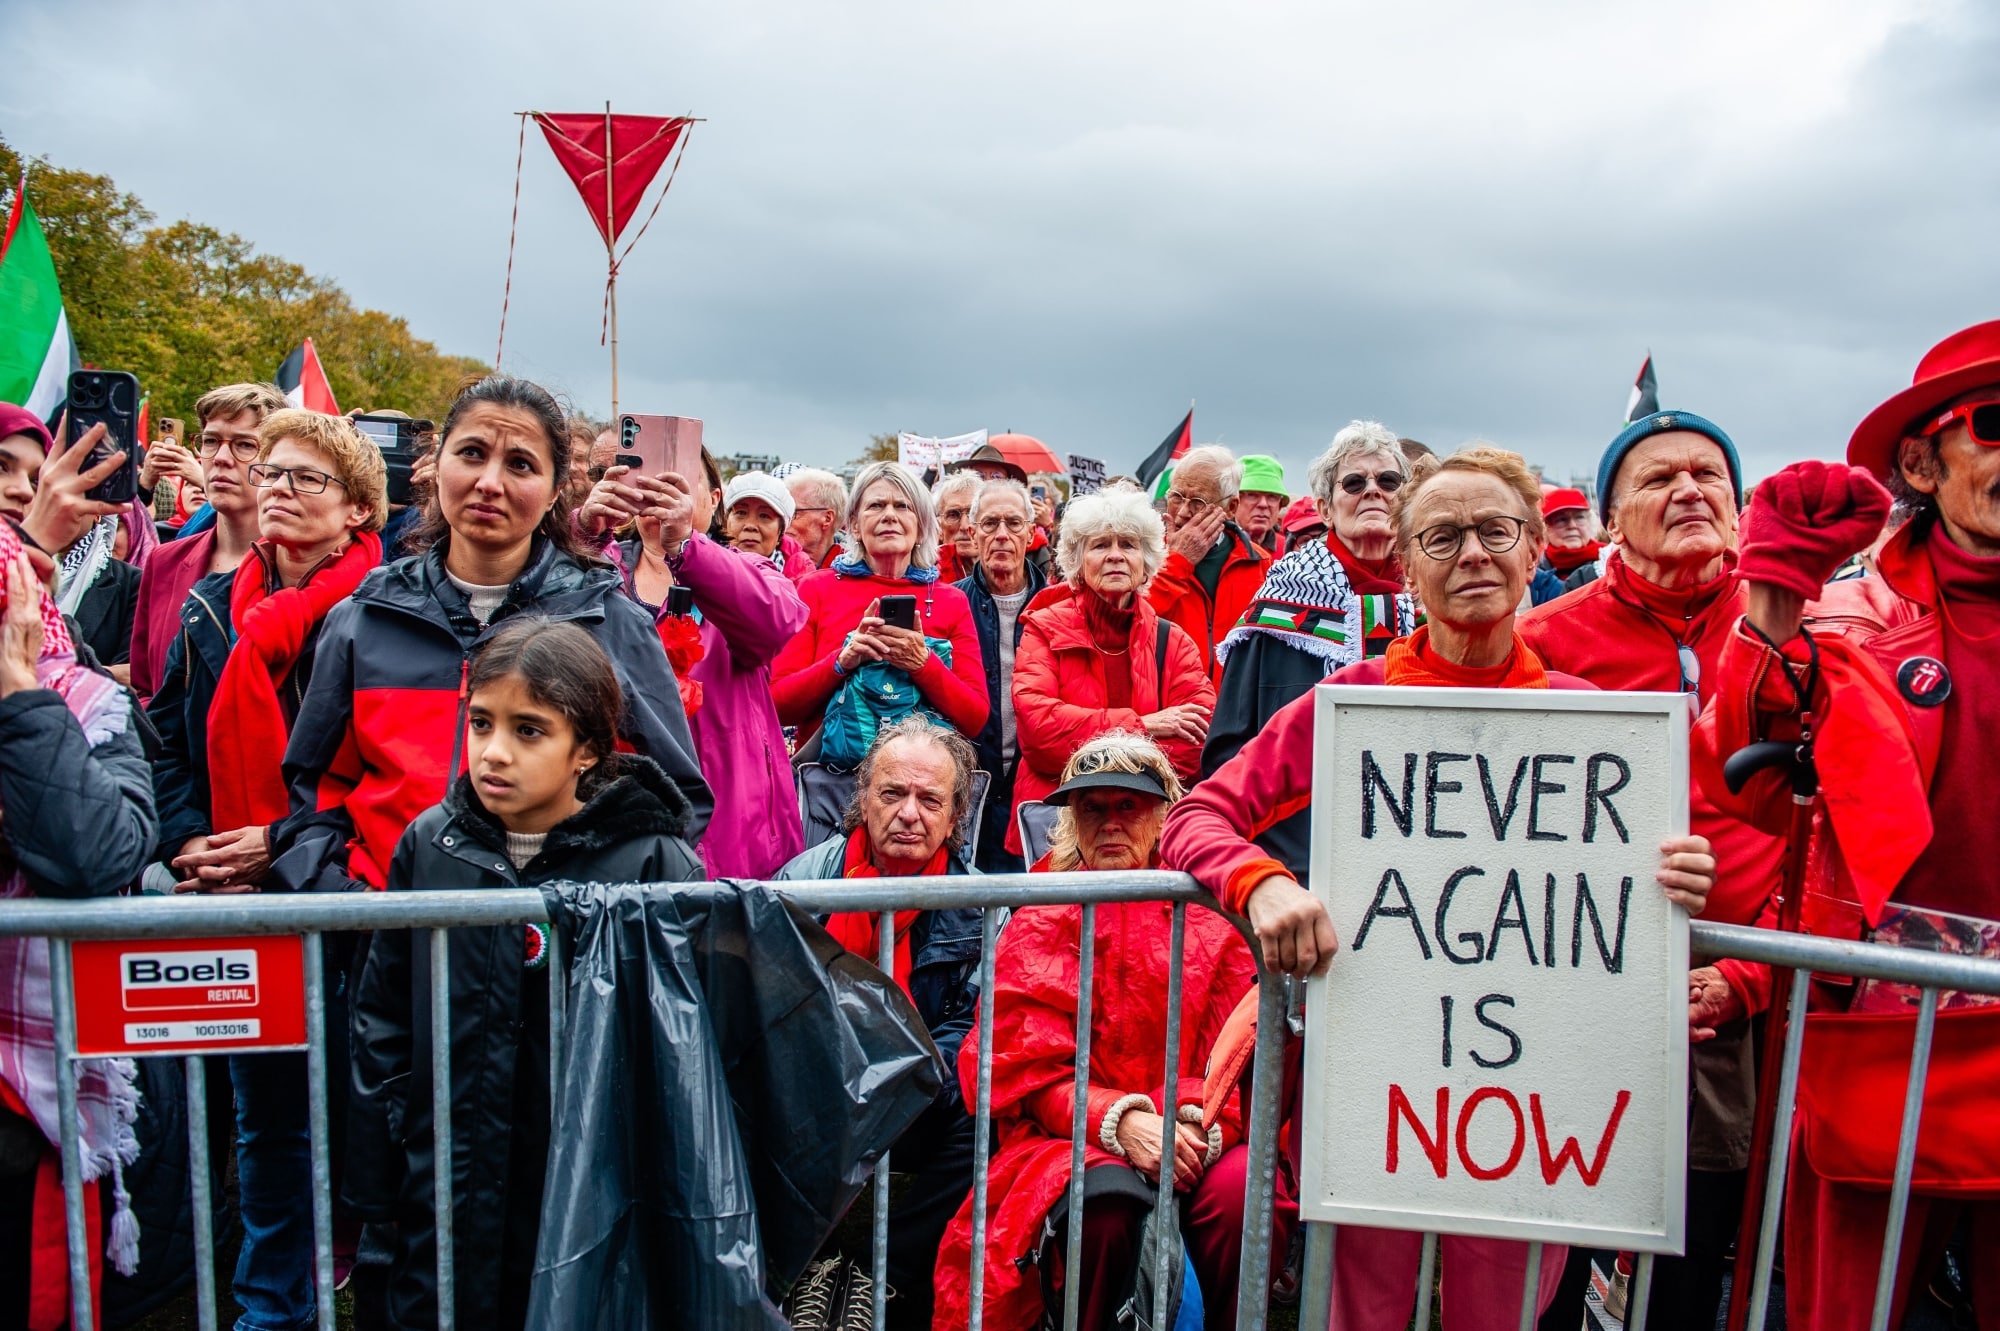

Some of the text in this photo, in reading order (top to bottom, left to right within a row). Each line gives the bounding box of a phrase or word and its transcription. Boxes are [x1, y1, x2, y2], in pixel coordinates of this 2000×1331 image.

[1069, 454, 1106, 477] JUSTICE
[1361, 750, 1631, 844] NEVER
[1352, 865, 1633, 974] AGAIN
[128, 957, 251, 984] Boels
[207, 989, 251, 1002] RENTAL
[136, 1024, 249, 1039] 13016 10013016
[1440, 993, 1523, 1069] IS
[1385, 1083, 1632, 1187] NOW
